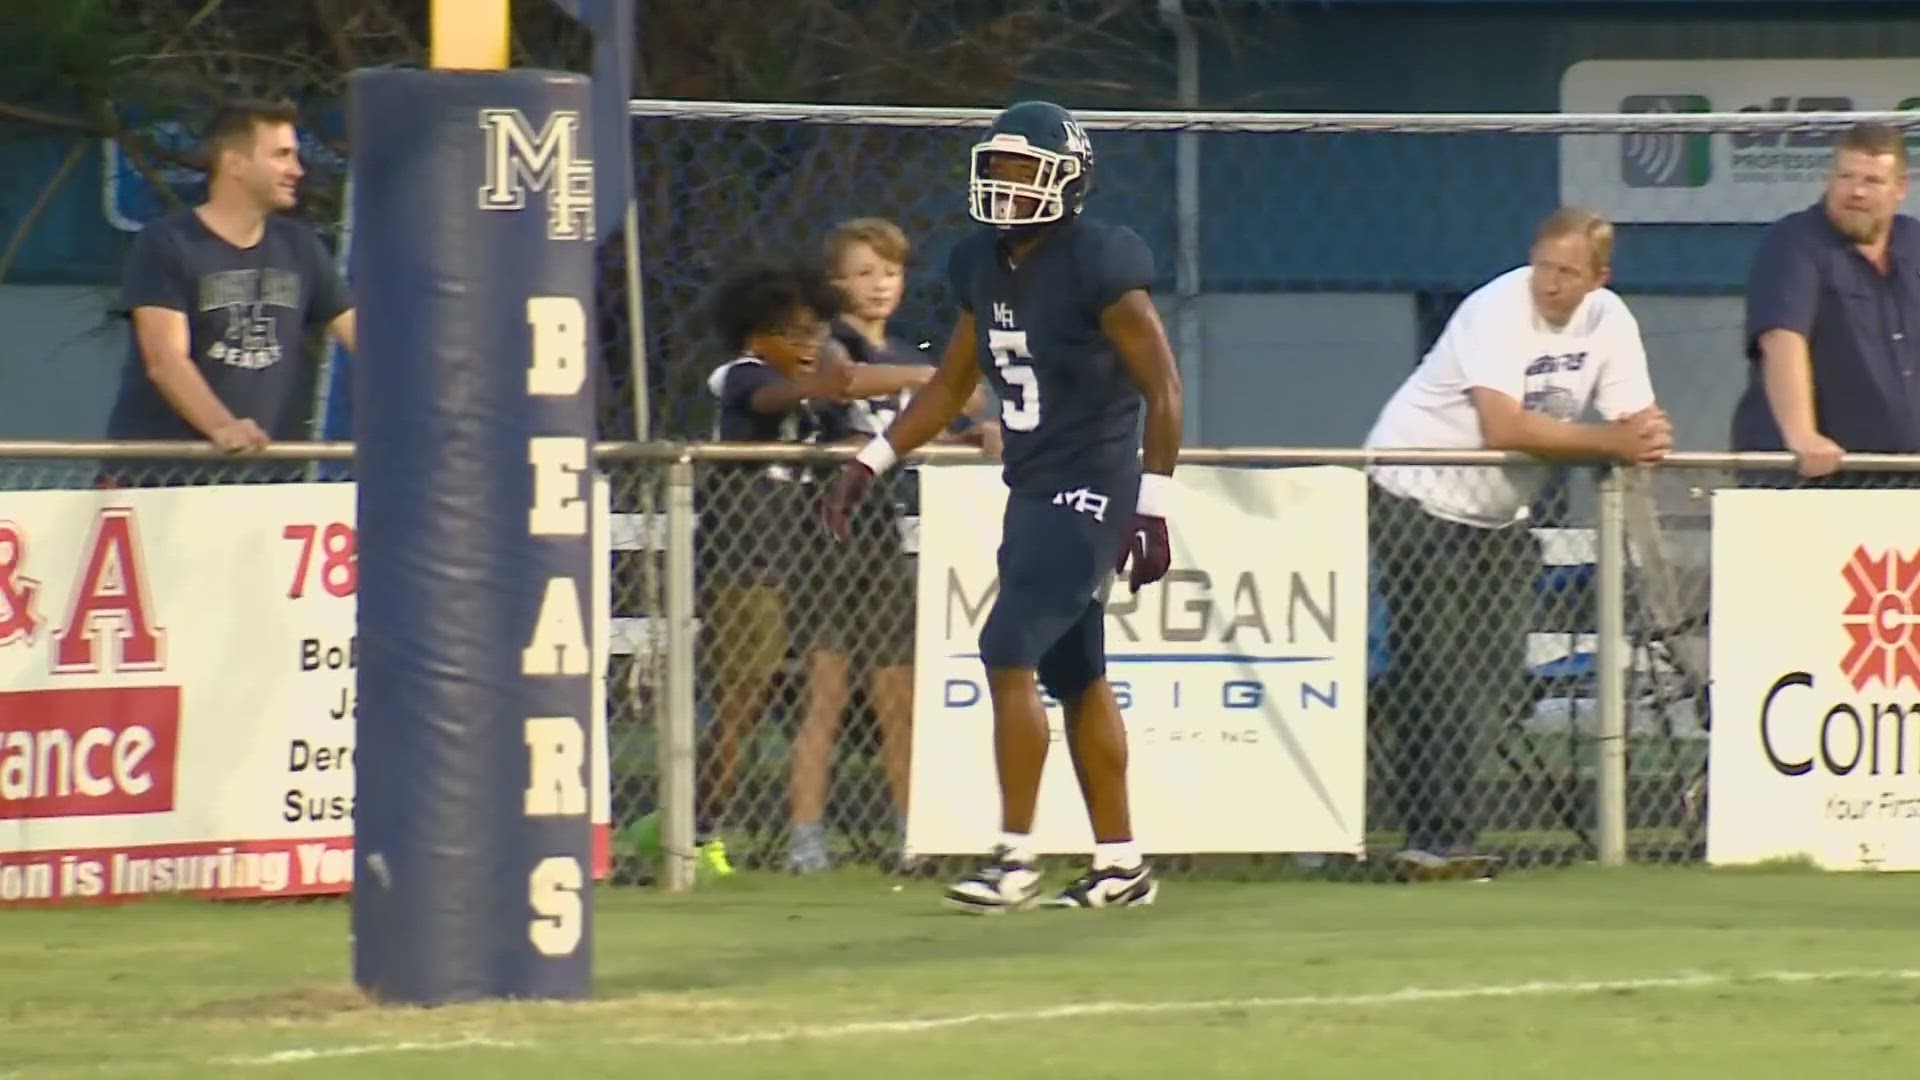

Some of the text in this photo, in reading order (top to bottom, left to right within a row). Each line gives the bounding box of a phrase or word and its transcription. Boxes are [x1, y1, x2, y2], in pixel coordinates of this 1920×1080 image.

[989, 329, 1041, 432] 5
[49, 507, 167, 674] A
[523, 297, 588, 956] BEARS
[945, 567, 1338, 643] MRGAN
[0, 725, 155, 799] ance
[290, 739, 356, 772] Der
[61, 855, 104, 897] is
[111, 849, 290, 893] Insuring
